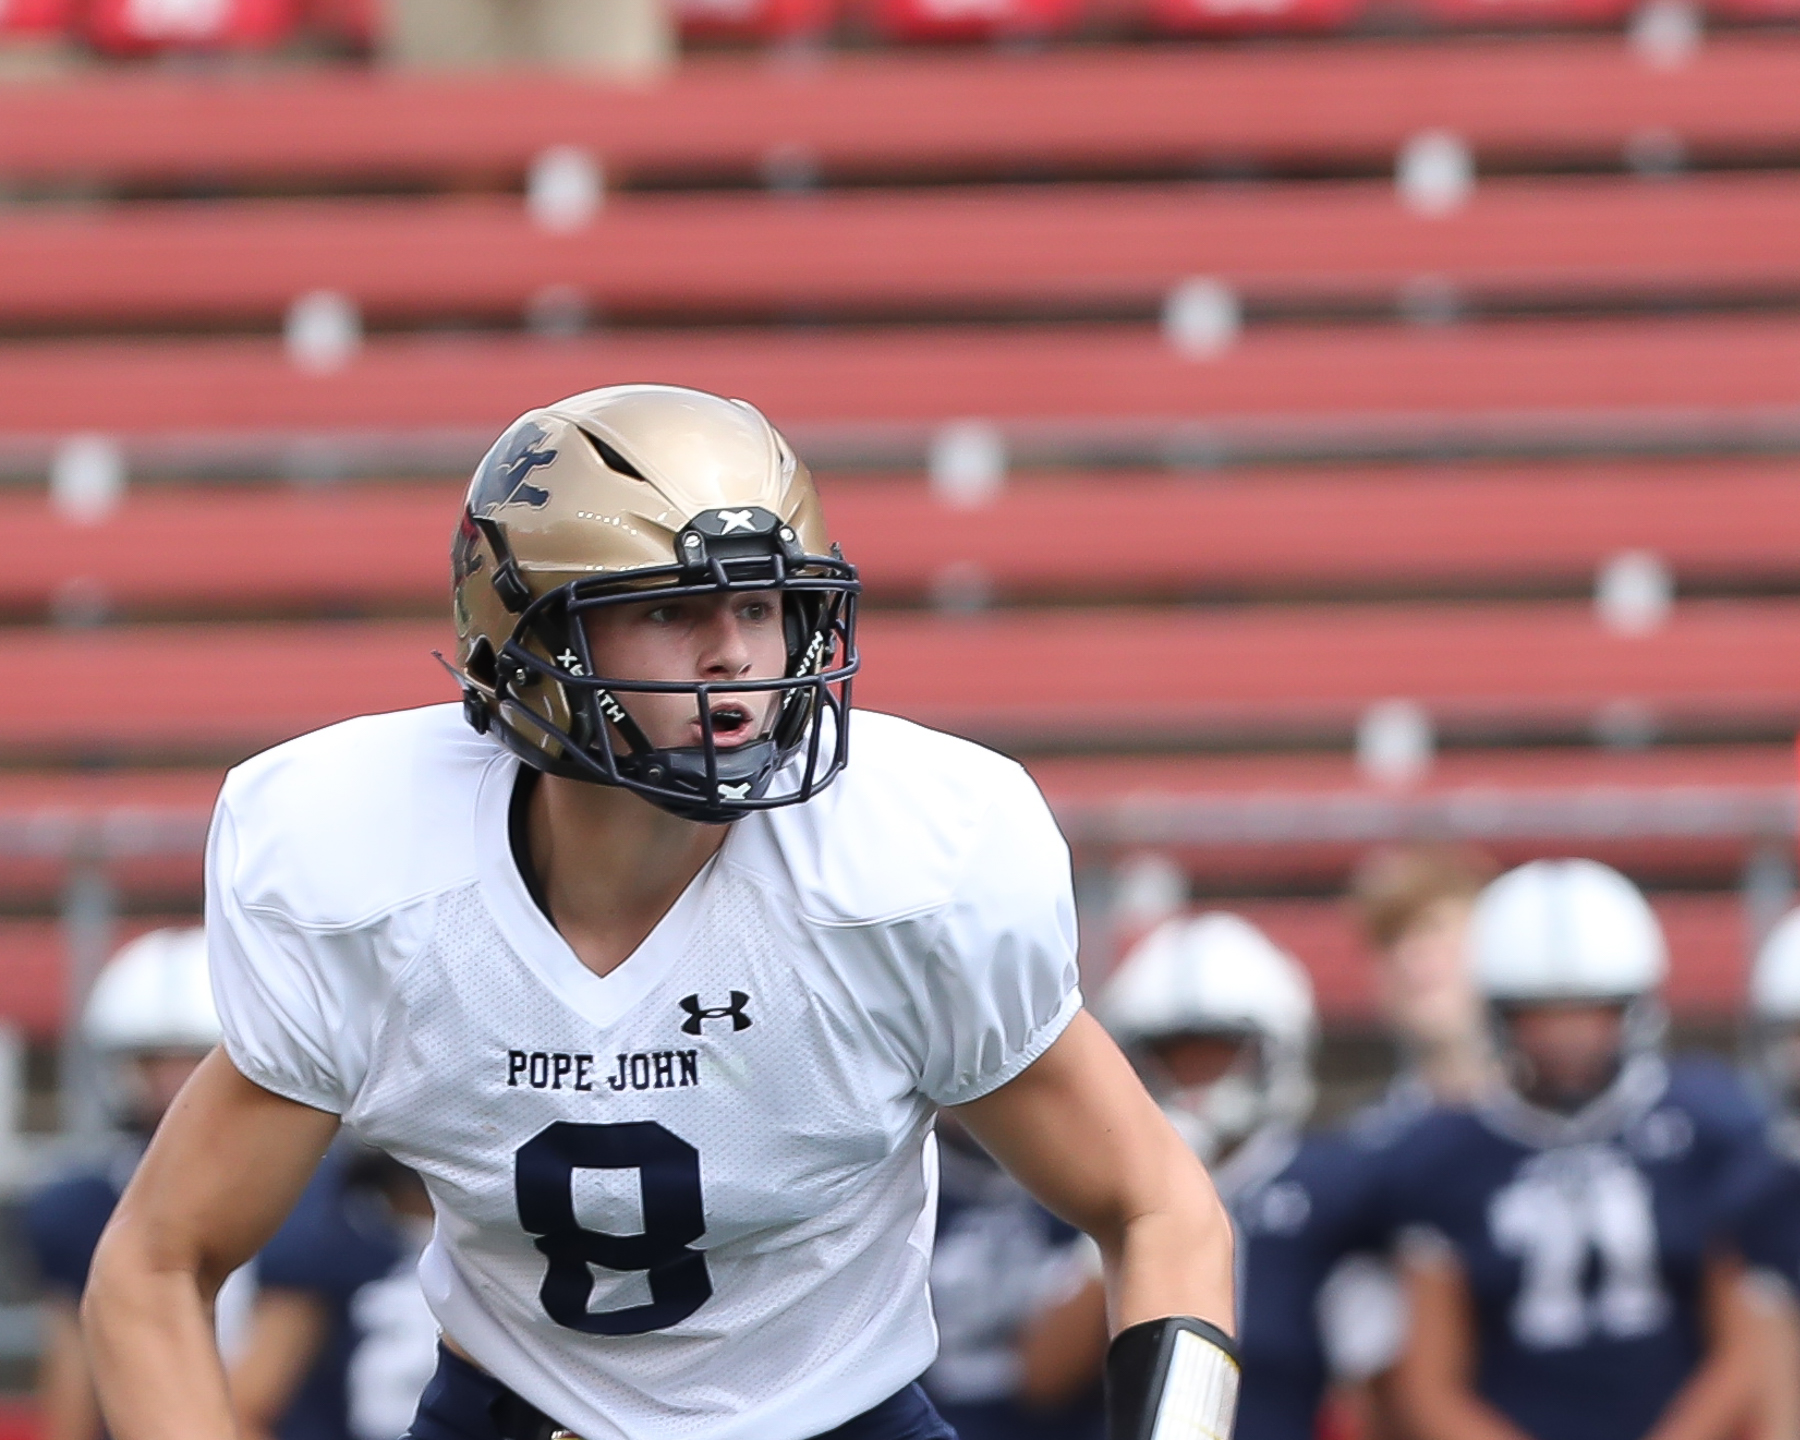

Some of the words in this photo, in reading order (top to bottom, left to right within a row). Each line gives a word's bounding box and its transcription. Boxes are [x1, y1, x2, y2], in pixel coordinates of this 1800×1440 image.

[507, 1049, 594, 1092] POPE
[607, 1049, 699, 1092] JOHN
[515, 1120, 714, 1337] 8
